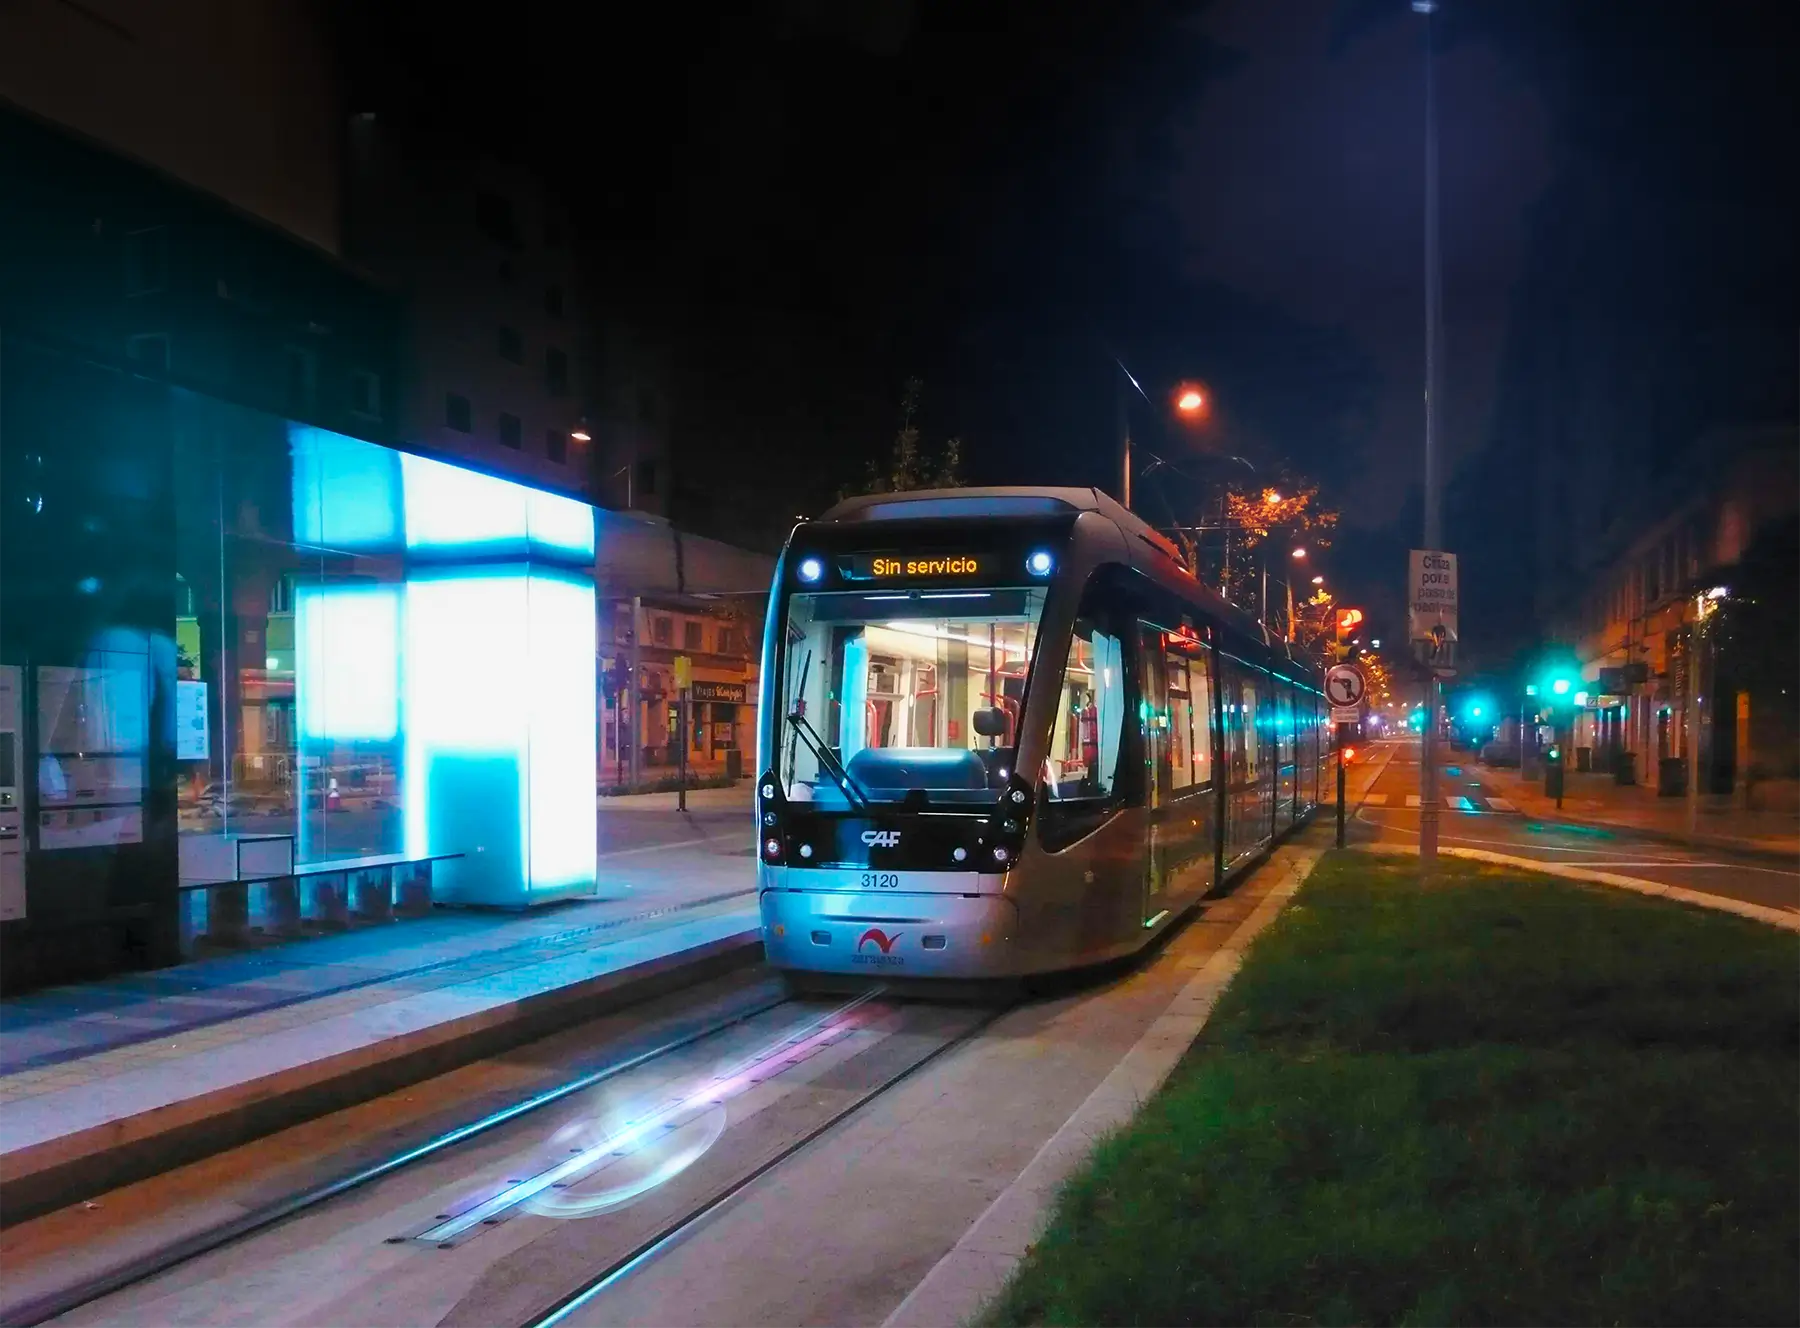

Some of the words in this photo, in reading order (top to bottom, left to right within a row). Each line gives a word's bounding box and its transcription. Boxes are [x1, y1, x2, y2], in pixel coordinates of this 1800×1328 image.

[873, 559, 900, 575] Sin
[907, 557, 977, 574] servicio
[861, 830, 901, 847] CAF
[861, 874, 899, 888] 3120
